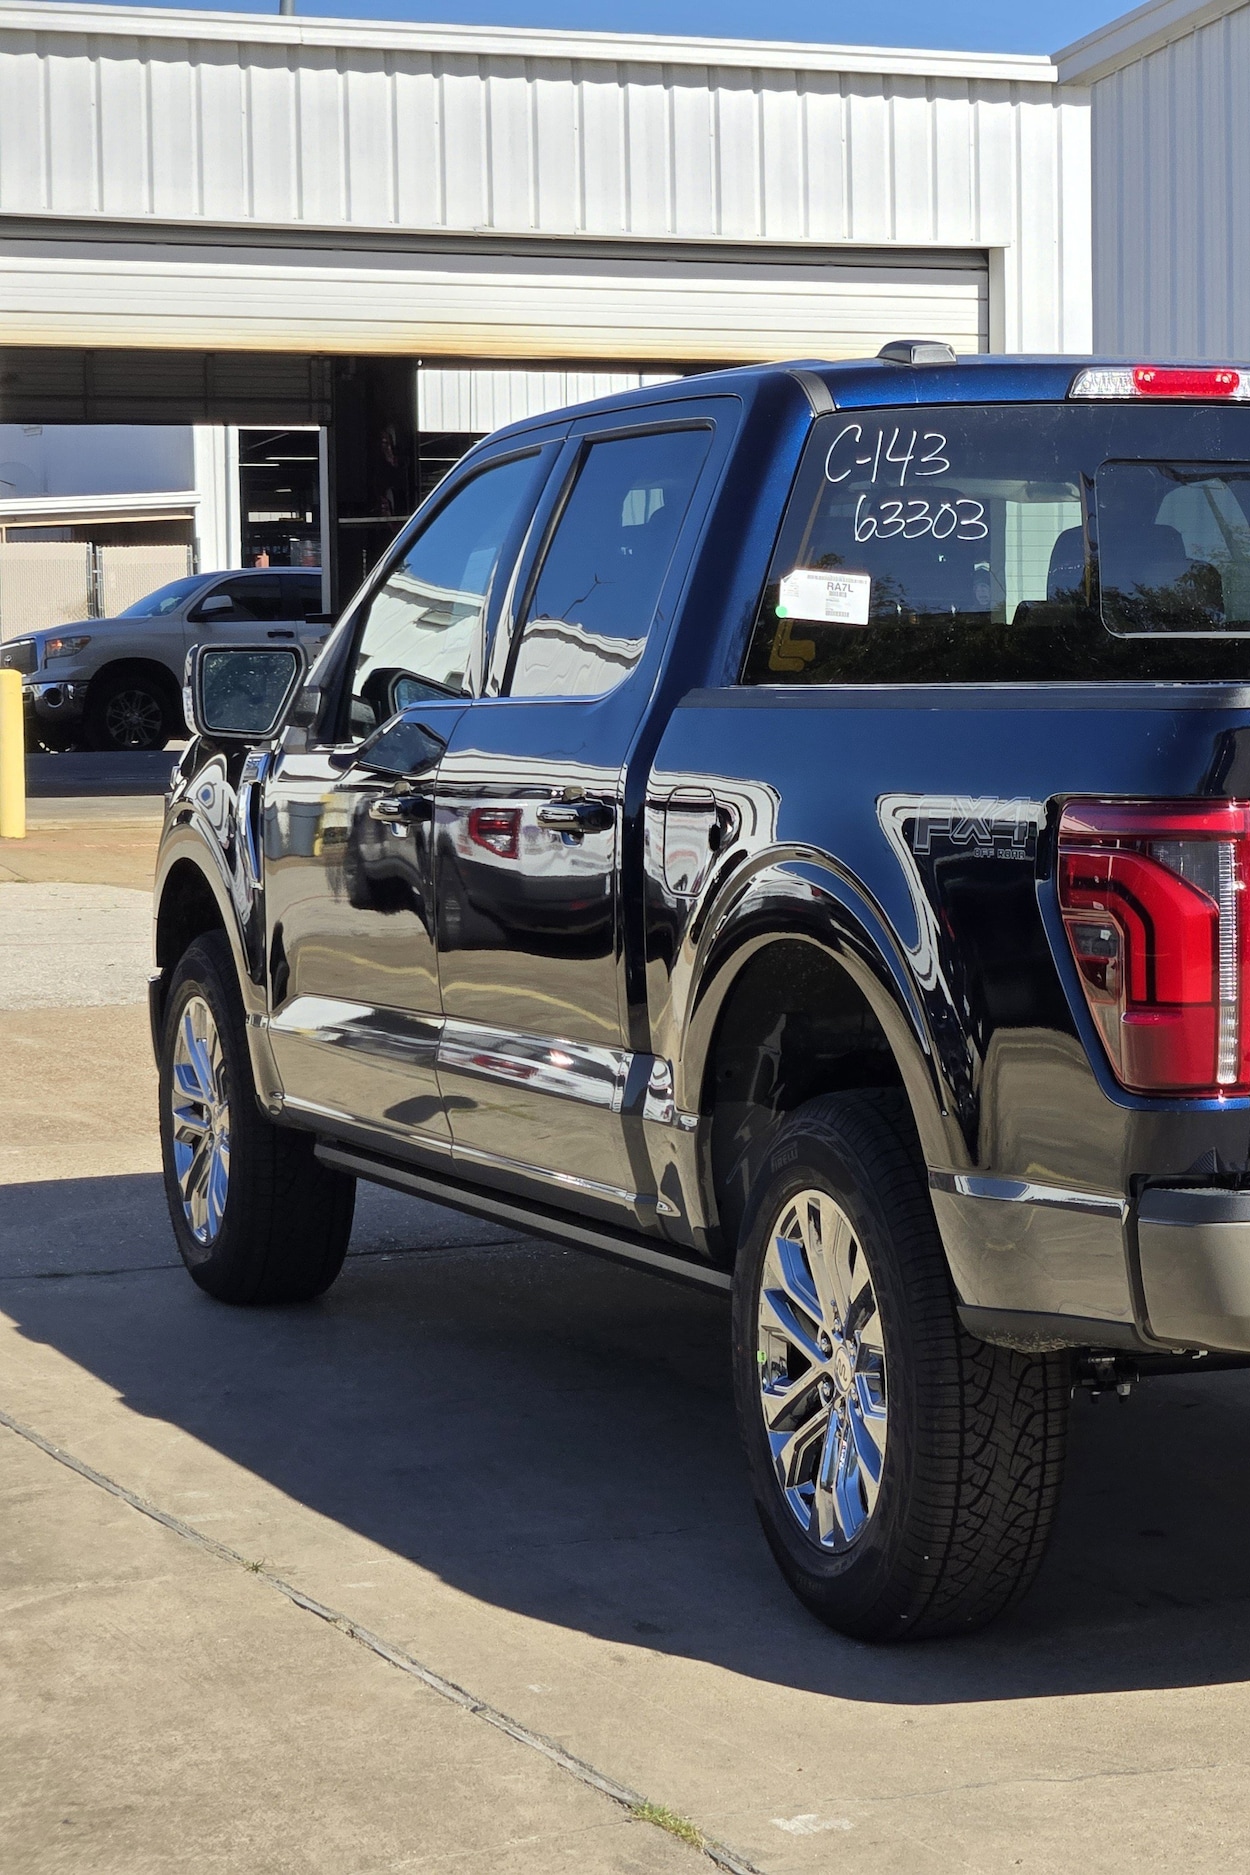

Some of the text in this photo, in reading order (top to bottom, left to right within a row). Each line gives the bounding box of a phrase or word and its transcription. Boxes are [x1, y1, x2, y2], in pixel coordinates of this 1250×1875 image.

[825, 424, 950, 486] C-143
[854, 494, 989, 542] 63303
[826, 581, 854, 593] RA7L
[913, 795, 1031, 855] FX4
[974, 848, 995, 859] OFF
